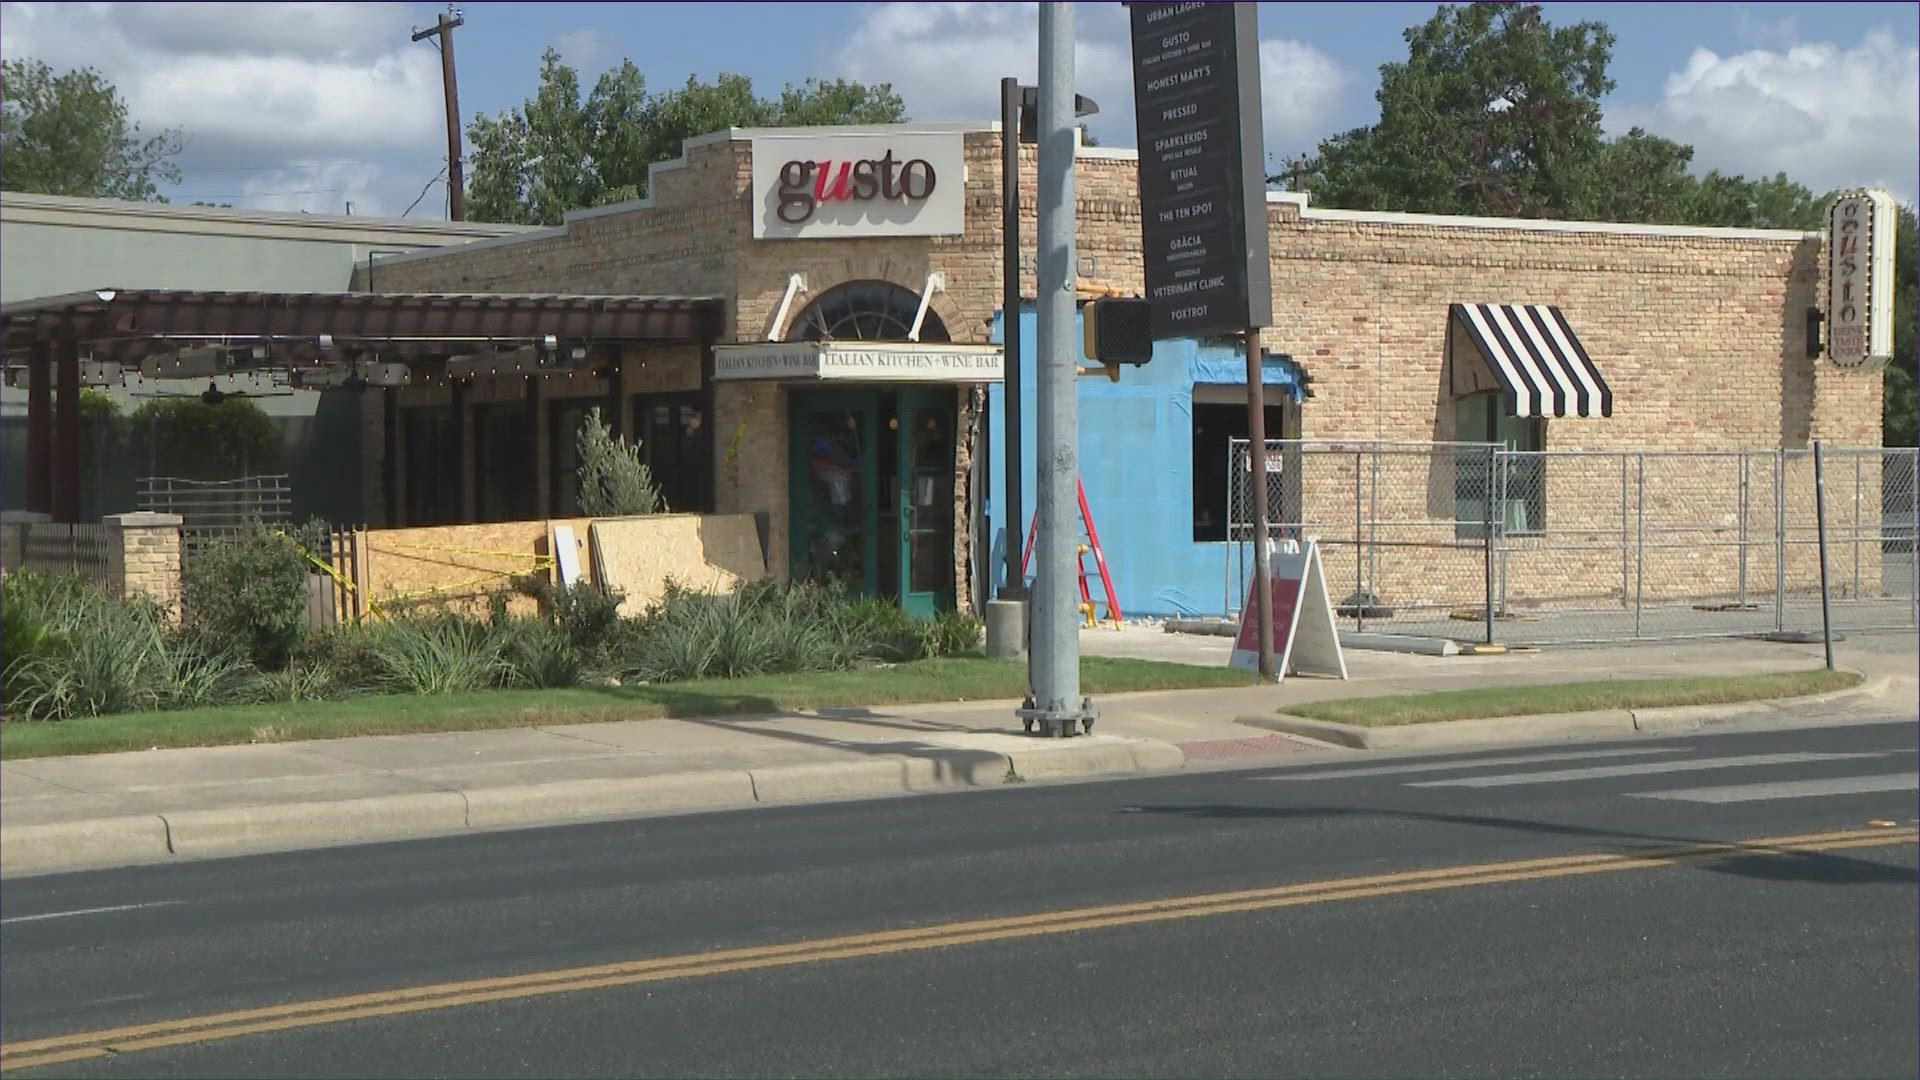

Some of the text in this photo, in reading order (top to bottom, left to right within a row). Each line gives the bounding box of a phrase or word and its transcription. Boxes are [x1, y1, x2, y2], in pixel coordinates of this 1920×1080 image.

[1147, 7, 1174, 23] URBAN
[1162, 31, 1190, 48] GUSTO
[1147, 65, 1211, 92] HONEST MARY'S
[1163, 103, 1198, 122] PRESSED
[1155, 129, 1208, 152] SPARKLEKIDS
[1170, 165, 1198, 180] RITUAL
[777, 149, 936, 223] gusto
[1158, 202, 1213, 222] THE TEN SPOT
[1153, 275, 1225, 298] VETERINARY CLINIC
[1171, 305, 1208, 320] FOXTROT
[802, 354, 817, 366] BAR
[825, 352, 874, 366] ITALIAN
[976, 357, 998, 368] BAR
